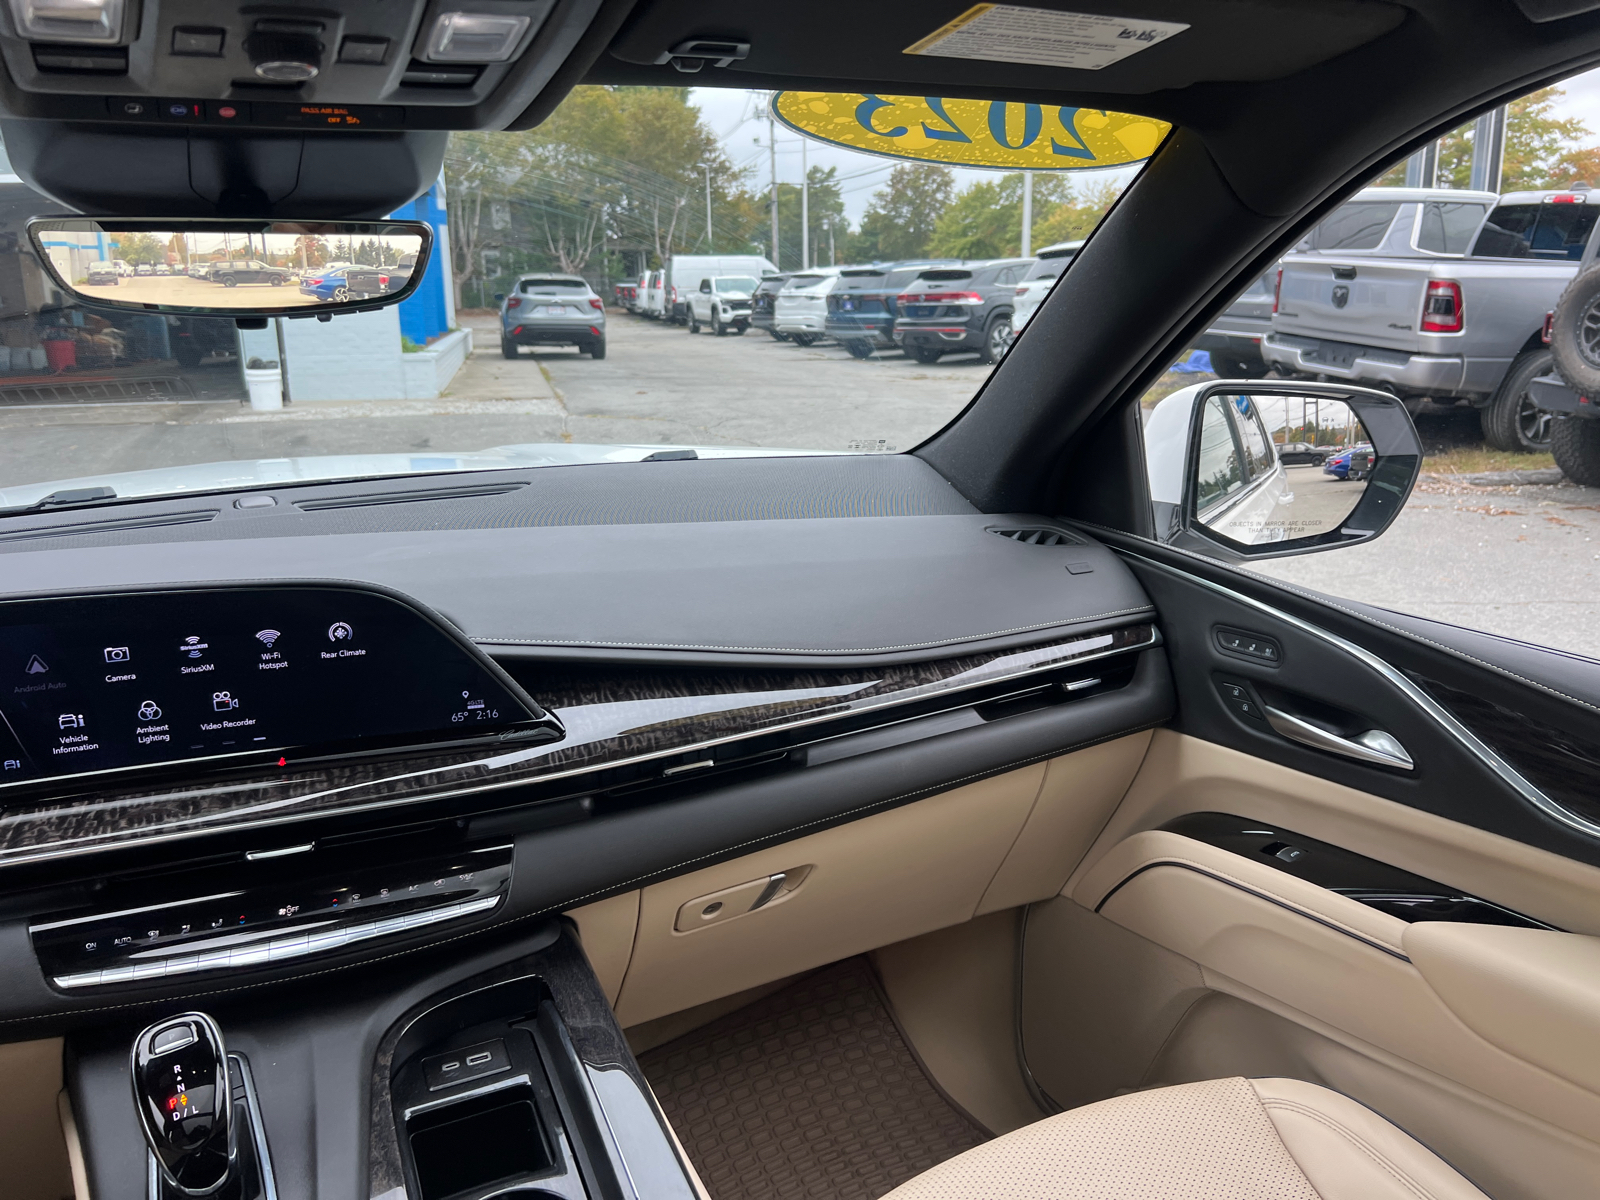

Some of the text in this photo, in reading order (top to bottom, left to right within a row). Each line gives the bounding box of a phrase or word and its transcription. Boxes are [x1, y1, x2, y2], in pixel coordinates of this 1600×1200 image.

[261, 652, 281, 660] Wi-Fi
[321, 649, 366, 659] Rear Climate
[181, 664, 215, 674] SiriusXM
[259, 661, 288, 670] Hotspot
[105, 673, 136, 682] Camera
[14, 681, 67, 693] Android Auto
[451, 709, 499, 722] 65° 2:16
[136, 724, 170, 734] Ambient
[200, 718, 256, 731] Video Recorder
[59, 734, 89, 744] Vehicle
[138, 733, 170, 744] Lighting
[52, 743, 99, 755] Information
[459, 873, 474, 881] SYNC
[114, 936, 132, 945] AUTO
[85, 942, 97, 950] ON
[174, 1064, 182, 1074] R
[177, 1083, 186, 1093] N
[169, 1097, 178, 1109] P
